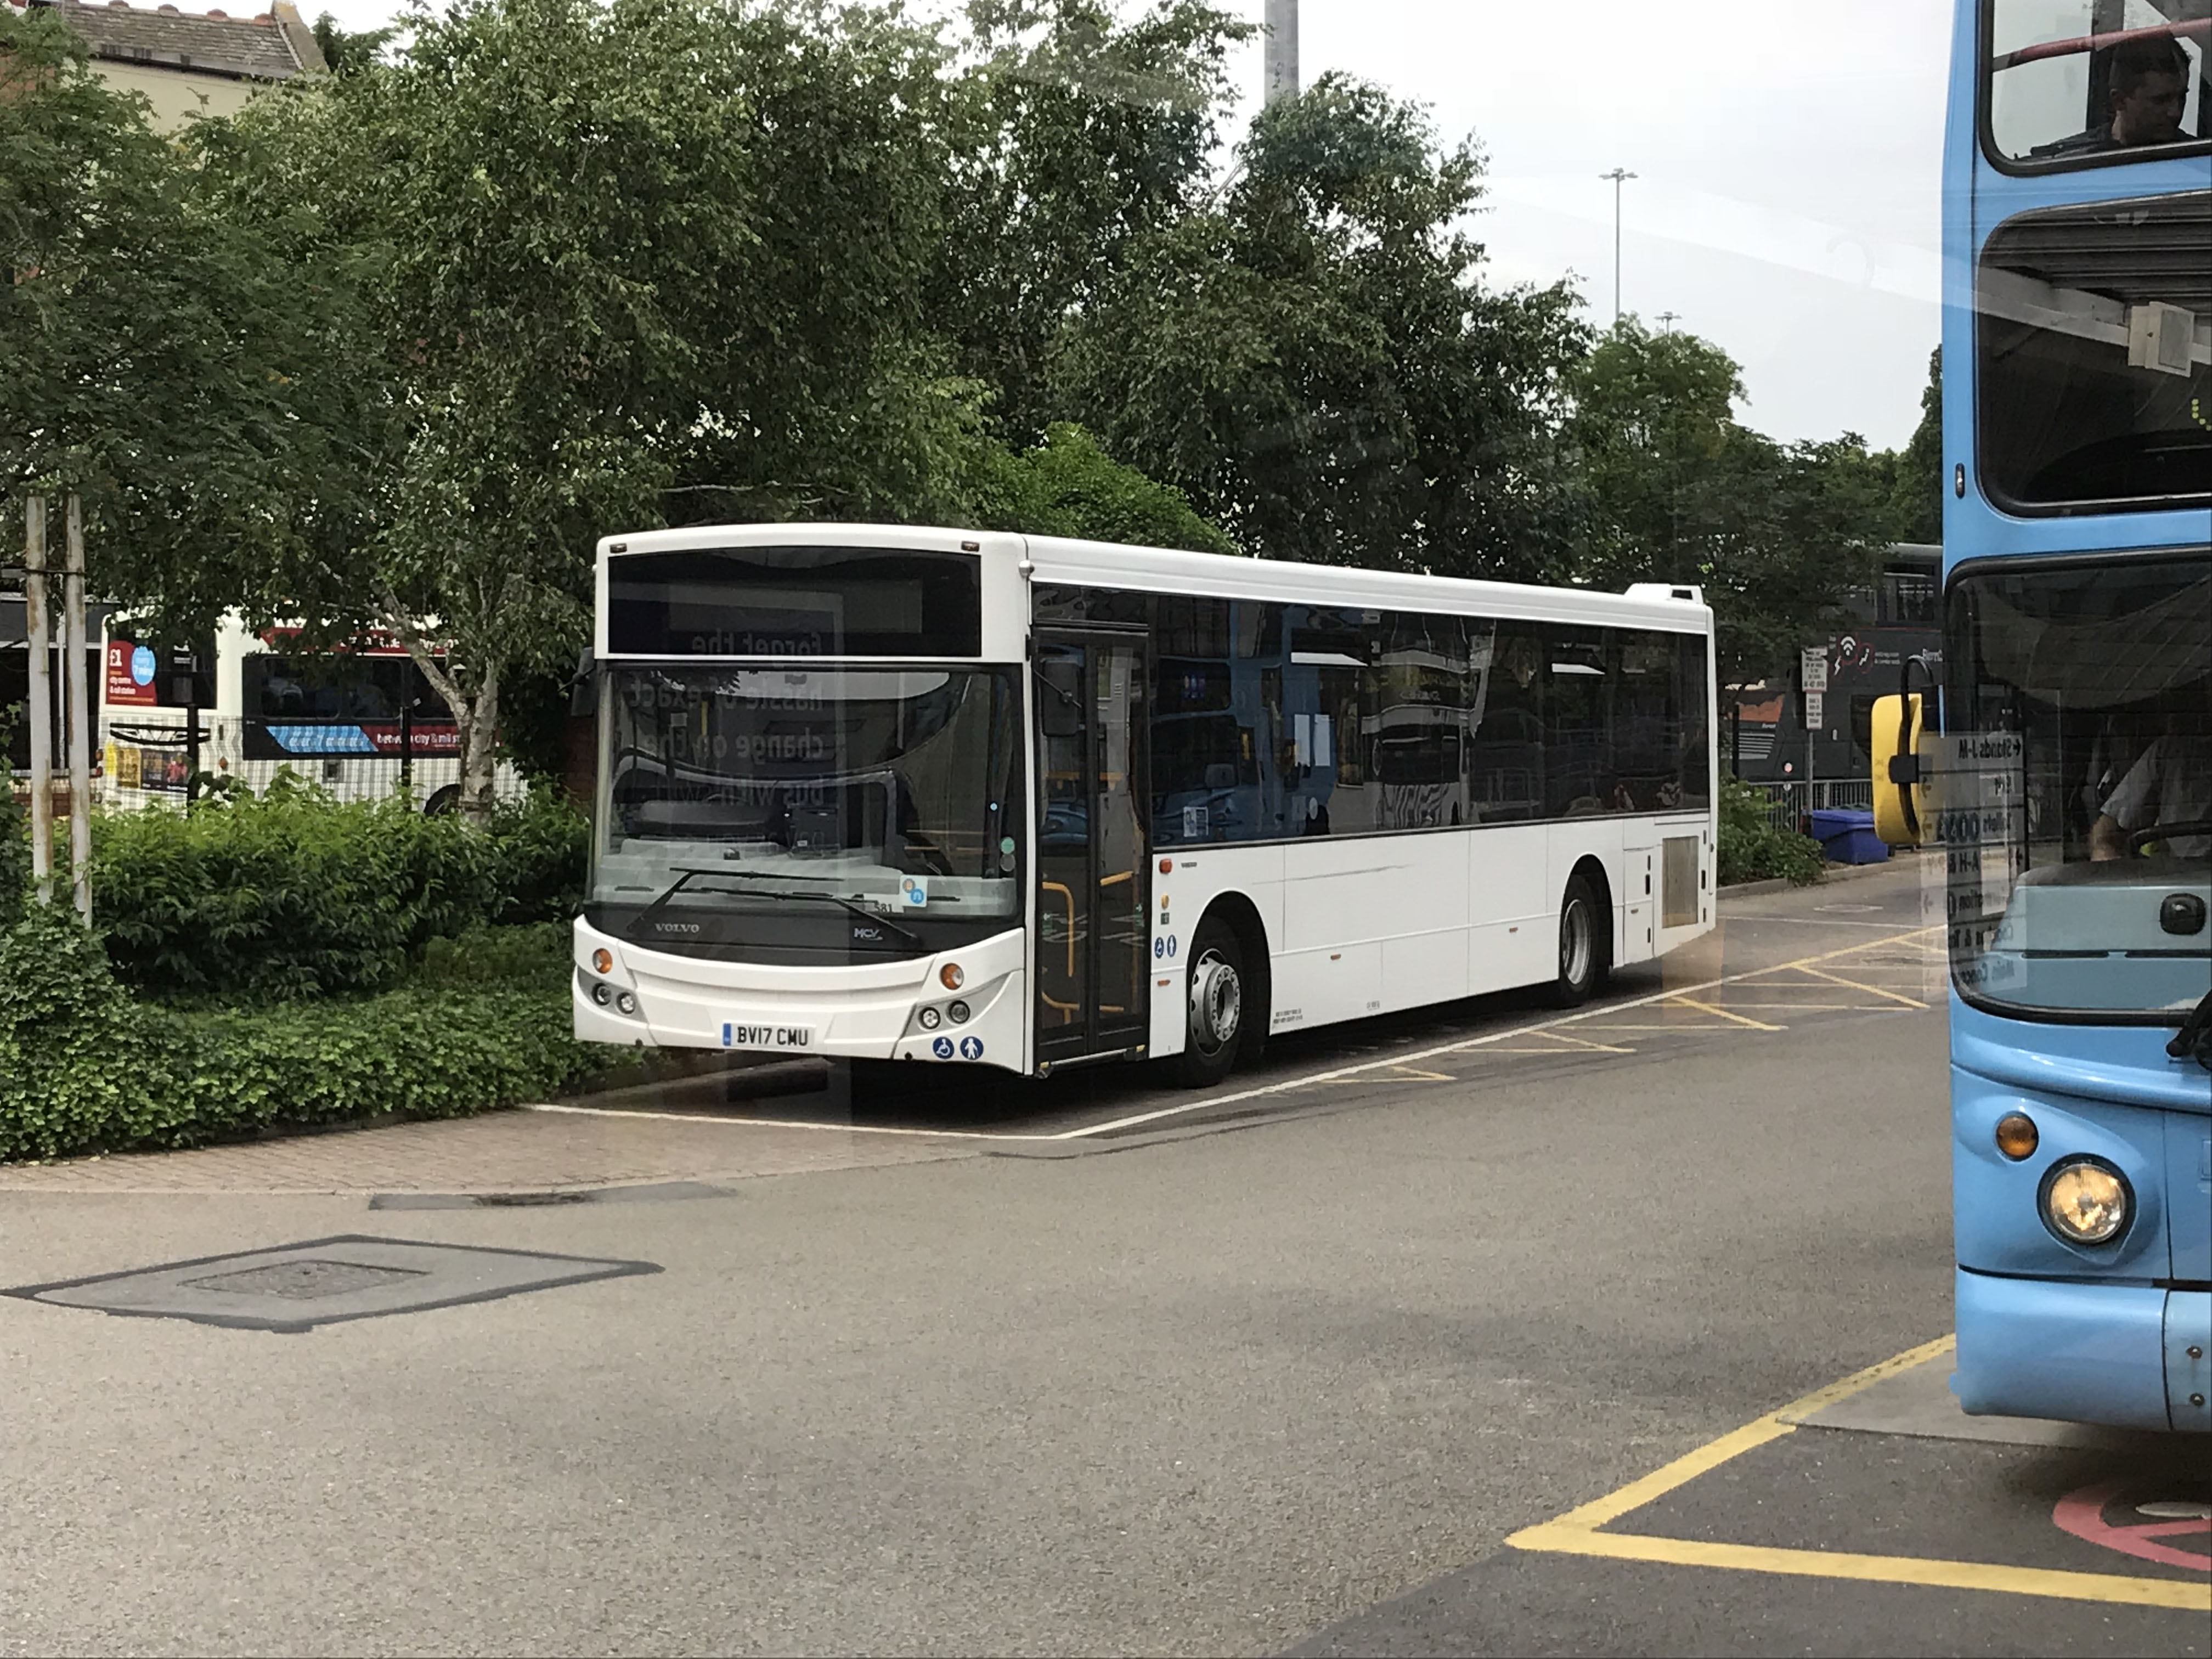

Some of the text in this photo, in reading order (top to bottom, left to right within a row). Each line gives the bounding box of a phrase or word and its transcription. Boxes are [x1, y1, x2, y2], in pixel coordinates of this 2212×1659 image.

[654, 922, 700, 934] VOLVO
[854, 927, 881, 940] MCV
[737, 1026, 808, 1047] BV17 CMU
